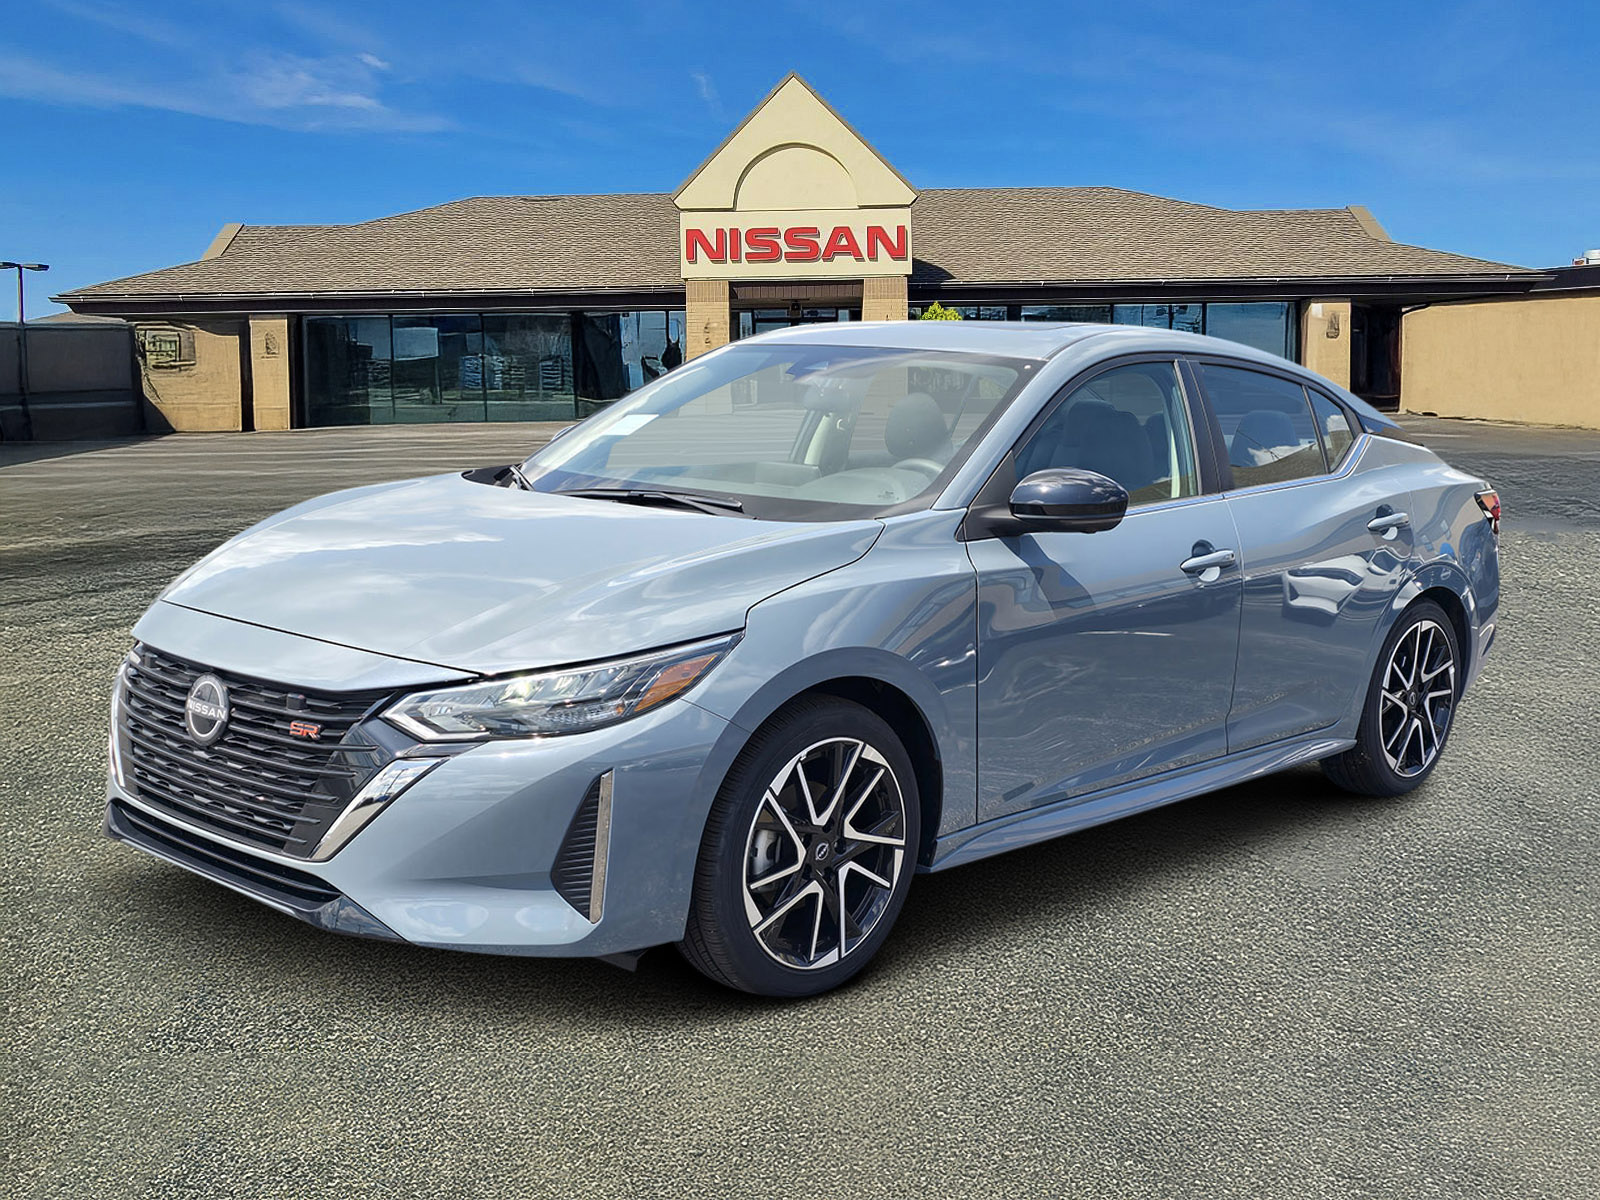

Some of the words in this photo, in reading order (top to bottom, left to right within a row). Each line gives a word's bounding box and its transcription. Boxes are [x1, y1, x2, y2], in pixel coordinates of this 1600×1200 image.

[686, 225, 907, 263] NISSAN
[189, 699, 226, 719] NISSAN
[290, 721, 319, 739] SR
